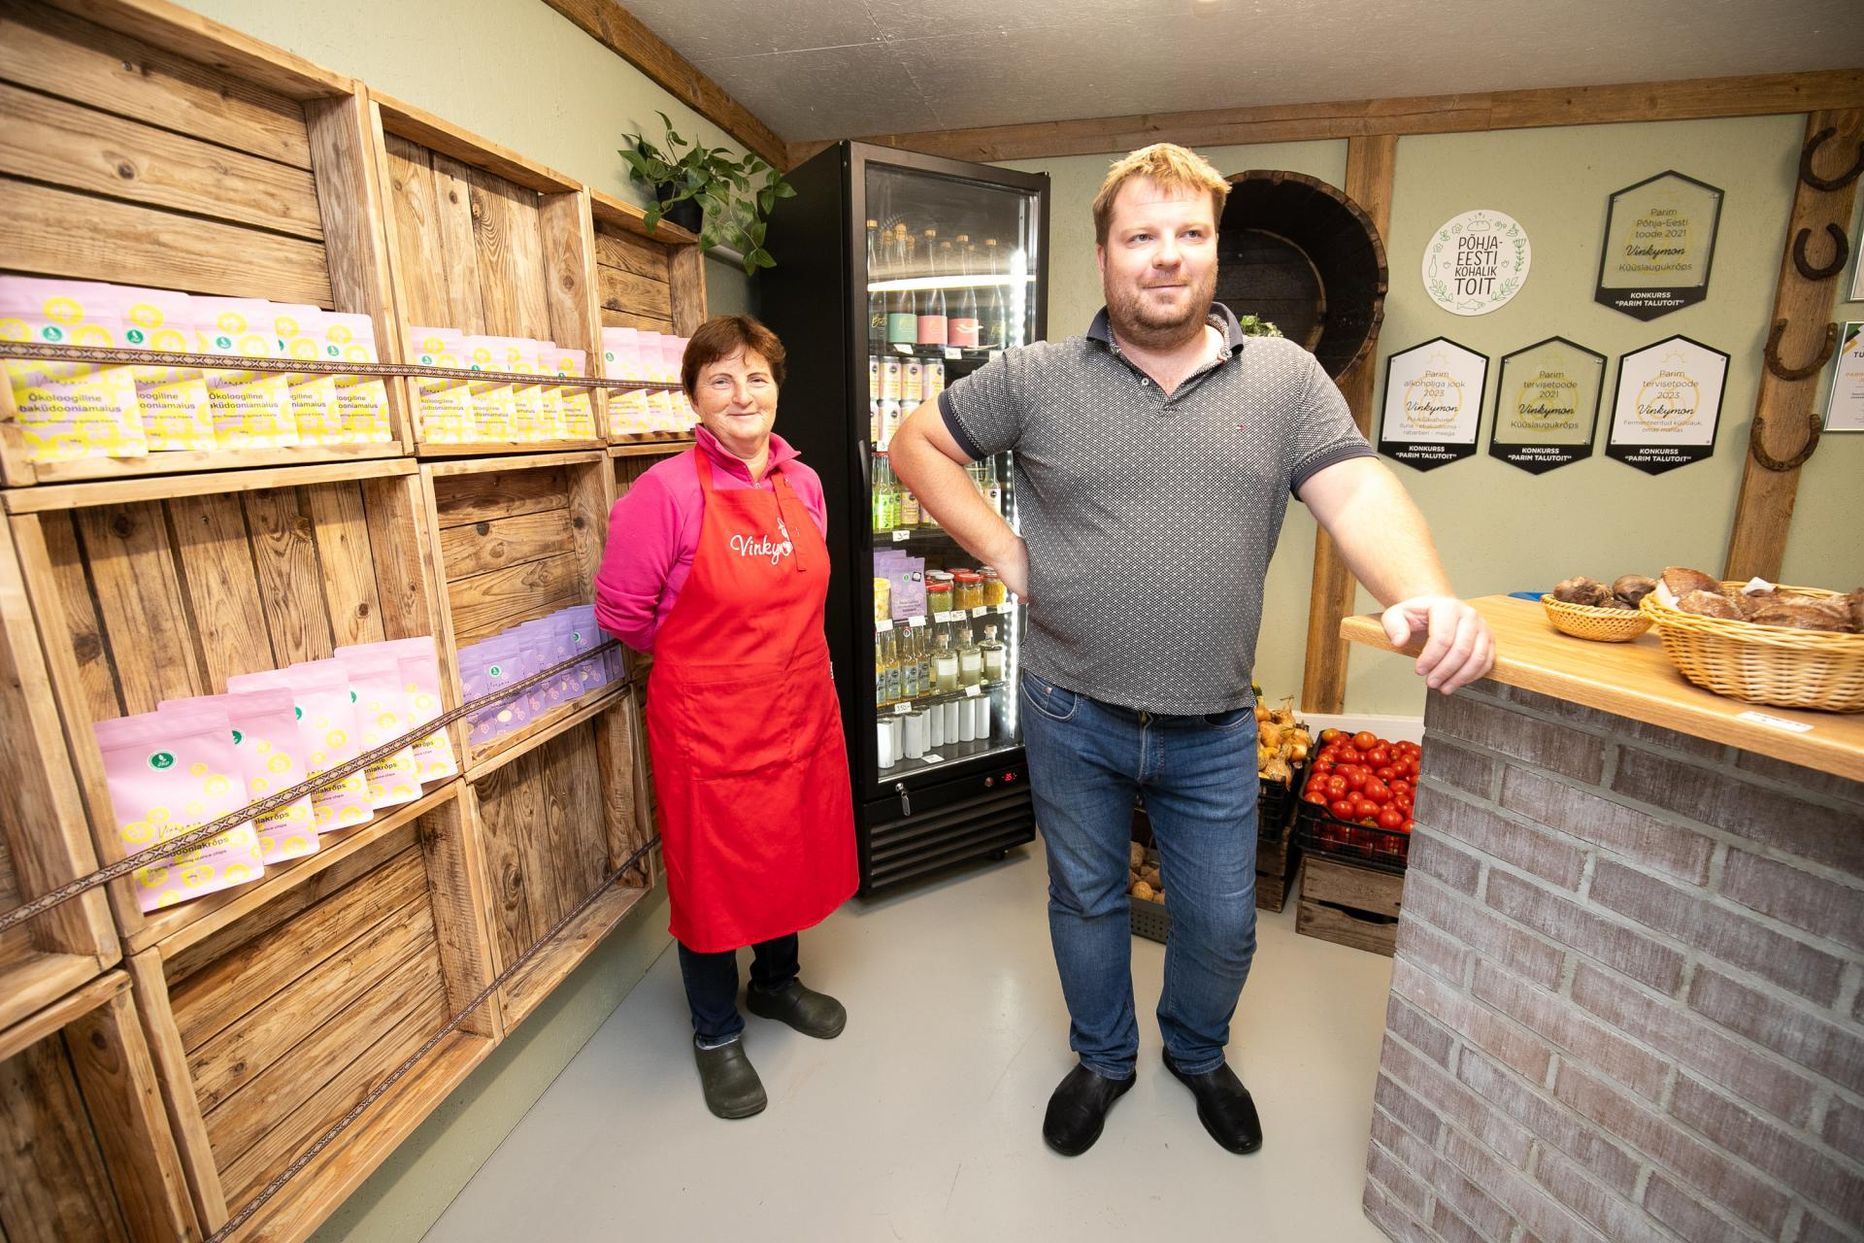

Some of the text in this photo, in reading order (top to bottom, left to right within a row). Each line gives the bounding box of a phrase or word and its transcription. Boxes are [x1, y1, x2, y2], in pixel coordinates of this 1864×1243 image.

[1650, 208, 1677, 216] Parim
[1636, 219, 1688, 228] Põhja-Eesti
[1636, 230, 1686, 238] toode 2021
[1458, 234, 1503, 250] PÕHJA-
[1456, 250, 1498, 266] EESTI
[1626, 244, 1686, 260] Vinkymon
[1455, 266, 1498, 277] KOHALIK
[1454, 278, 1496, 295] TOIT
[1540, 370, 1564, 378] Parim
[1643, 380, 1699, 388] tervisetoode
[1540, 390, 1559, 398] 2021
[1406, 401, 1458, 415] Vinkymon
[1519, 404, 1574, 418] Vinkymon
[1638, 404, 1694, 418] Vinkymon
